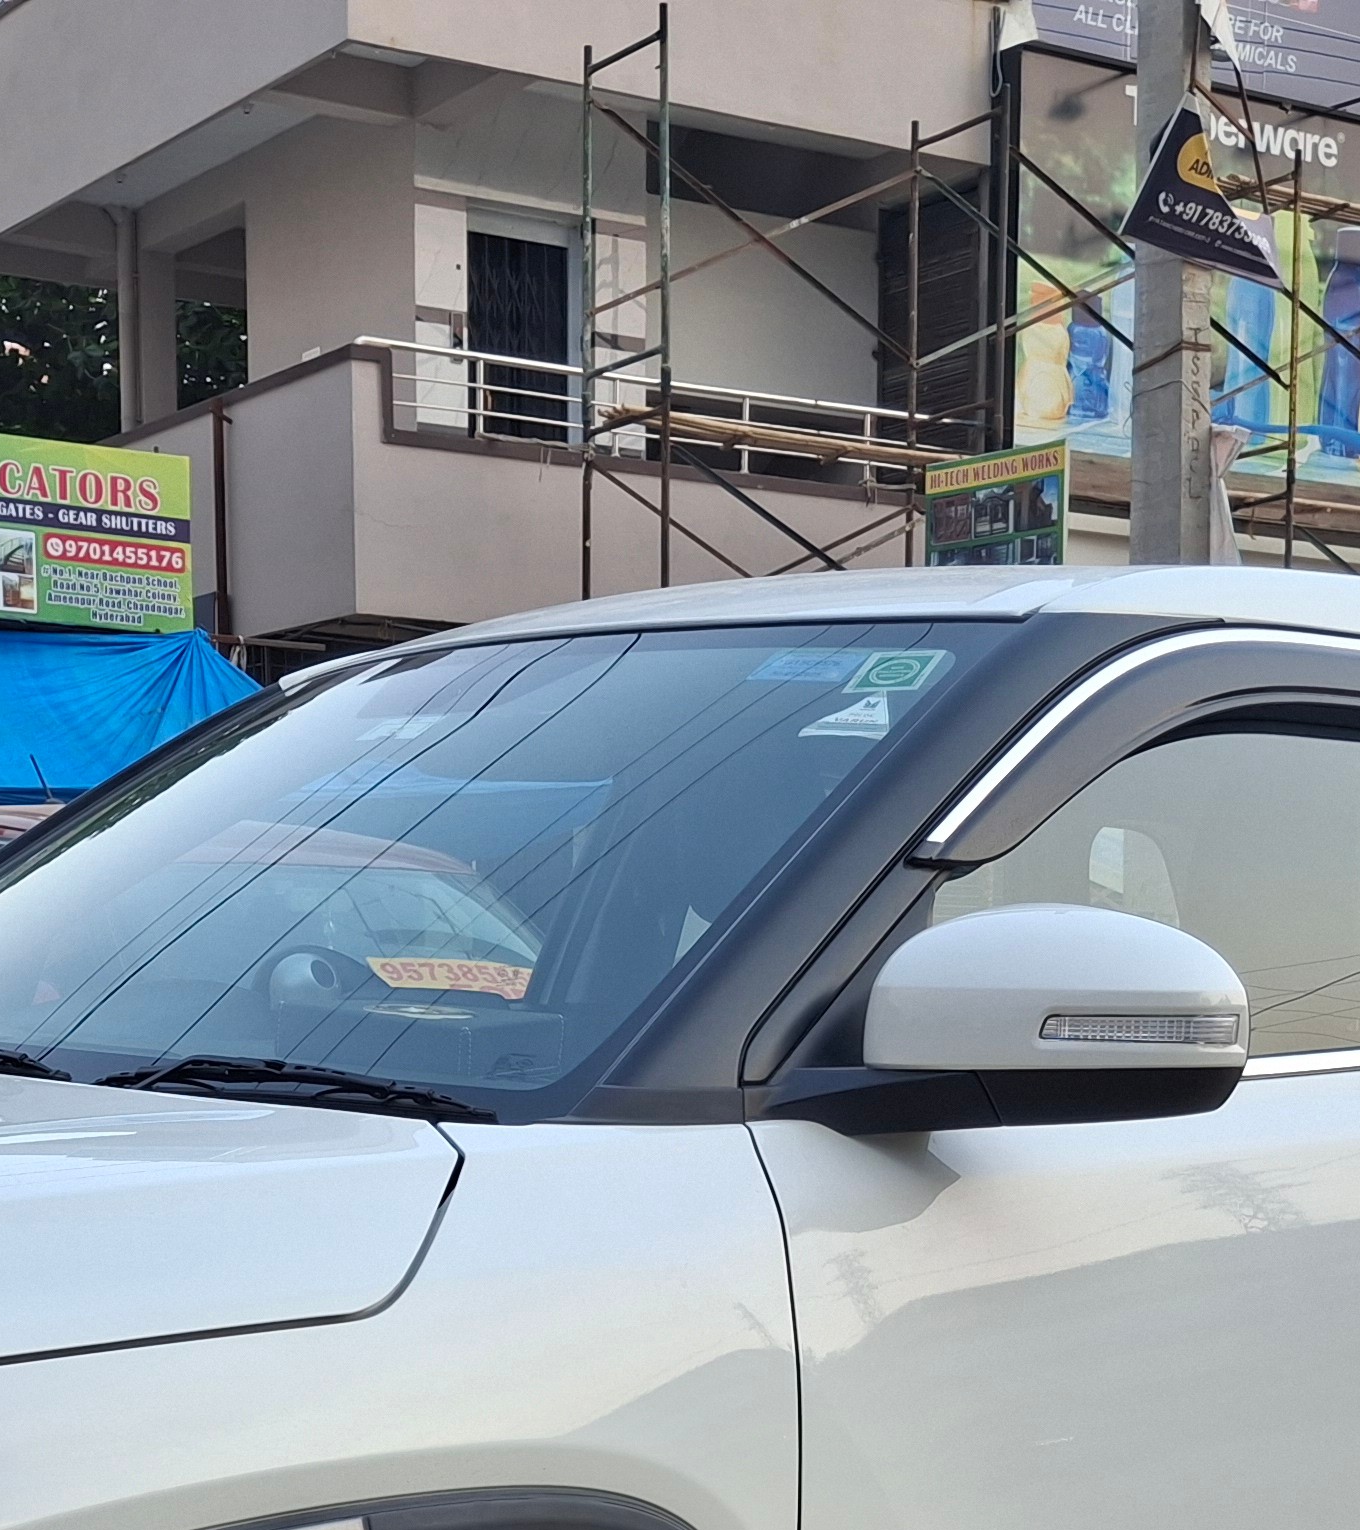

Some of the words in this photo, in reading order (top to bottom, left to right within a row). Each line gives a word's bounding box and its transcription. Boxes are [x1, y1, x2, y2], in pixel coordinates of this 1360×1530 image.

[1073, 5, 1108, 30] ALL
[1112, 15, 1138, 35] CL
[1248, 19, 1284, 43] FOR
[1236, 43, 1297, 73] MICALS
[930, 468, 969, 490] HI-TECH
[972, 459, 1018, 482] WELDING
[1021, 450, 1059, 473] WORKS
[58, 509, 97, 527] GEAR
[101, 514, 176, 536] SHUTTERS
[65, 540, 183, 569] 9701455176
[52, 579, 77, 591] Road
[77, 568, 100, 580] Near
[102, 571, 143, 586] Bachpan
[91, 610, 142, 625] Hyderabad
